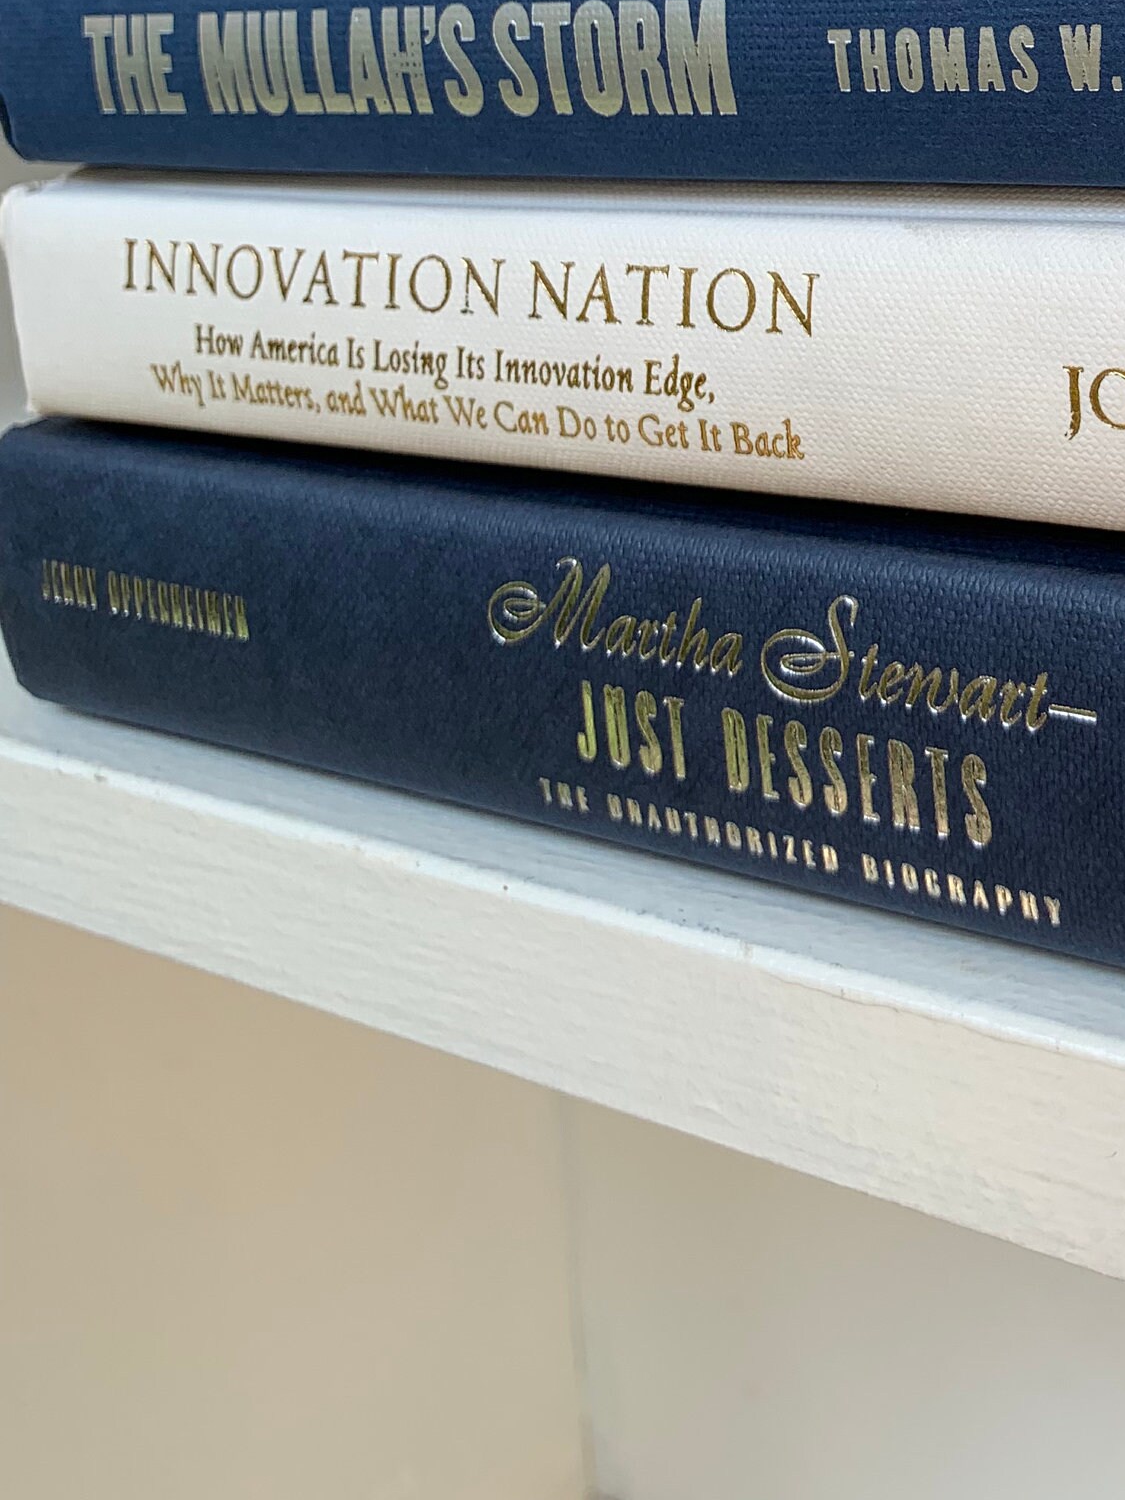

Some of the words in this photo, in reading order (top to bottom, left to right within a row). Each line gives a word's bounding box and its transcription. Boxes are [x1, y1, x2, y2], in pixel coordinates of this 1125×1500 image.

[83, 12, 187, 115] THE
[197, 1, 485, 118] MULLAH'S
[827, 24, 1039, 94] THOMAS
[1058, 24, 1123, 92] W.
[122, 238, 505, 318] INNOVATION
[529, 260, 821, 337] NATION
[150, 360, 206, 409] Why
[207, 369, 226, 400] It
[231, 373, 321, 414] Matters,
[326, 380, 367, 417] and
[369, 383, 439, 424] What
[445, 394, 488, 430] We
[494, 400, 549, 436] Can
[556, 405, 597, 440] Do
[604, 414, 630, 445] to
[638, 413, 690, 449] Get
[698, 418, 722, 452] It
[730, 418, 805, 461] Back
[194, 322, 244, 357] How
[250, 329, 339, 368] America
[346, 336, 365, 370] Is
[372, 339, 448, 390] Losing
[456, 345, 485, 382] Its
[494, 348, 634, 393] Innovation
[643, 353, 715, 413] Edge,
[487, 555, 744, 679] Martha
[577, 679, 686, 781] JUST
[721, 706, 993, 849] DESSERTS
[538, 775, 590, 814] THE
[607, 791, 840, 875] UNAUTHORIZED
[860, 851, 1063, 928] BIOGRAPHY
